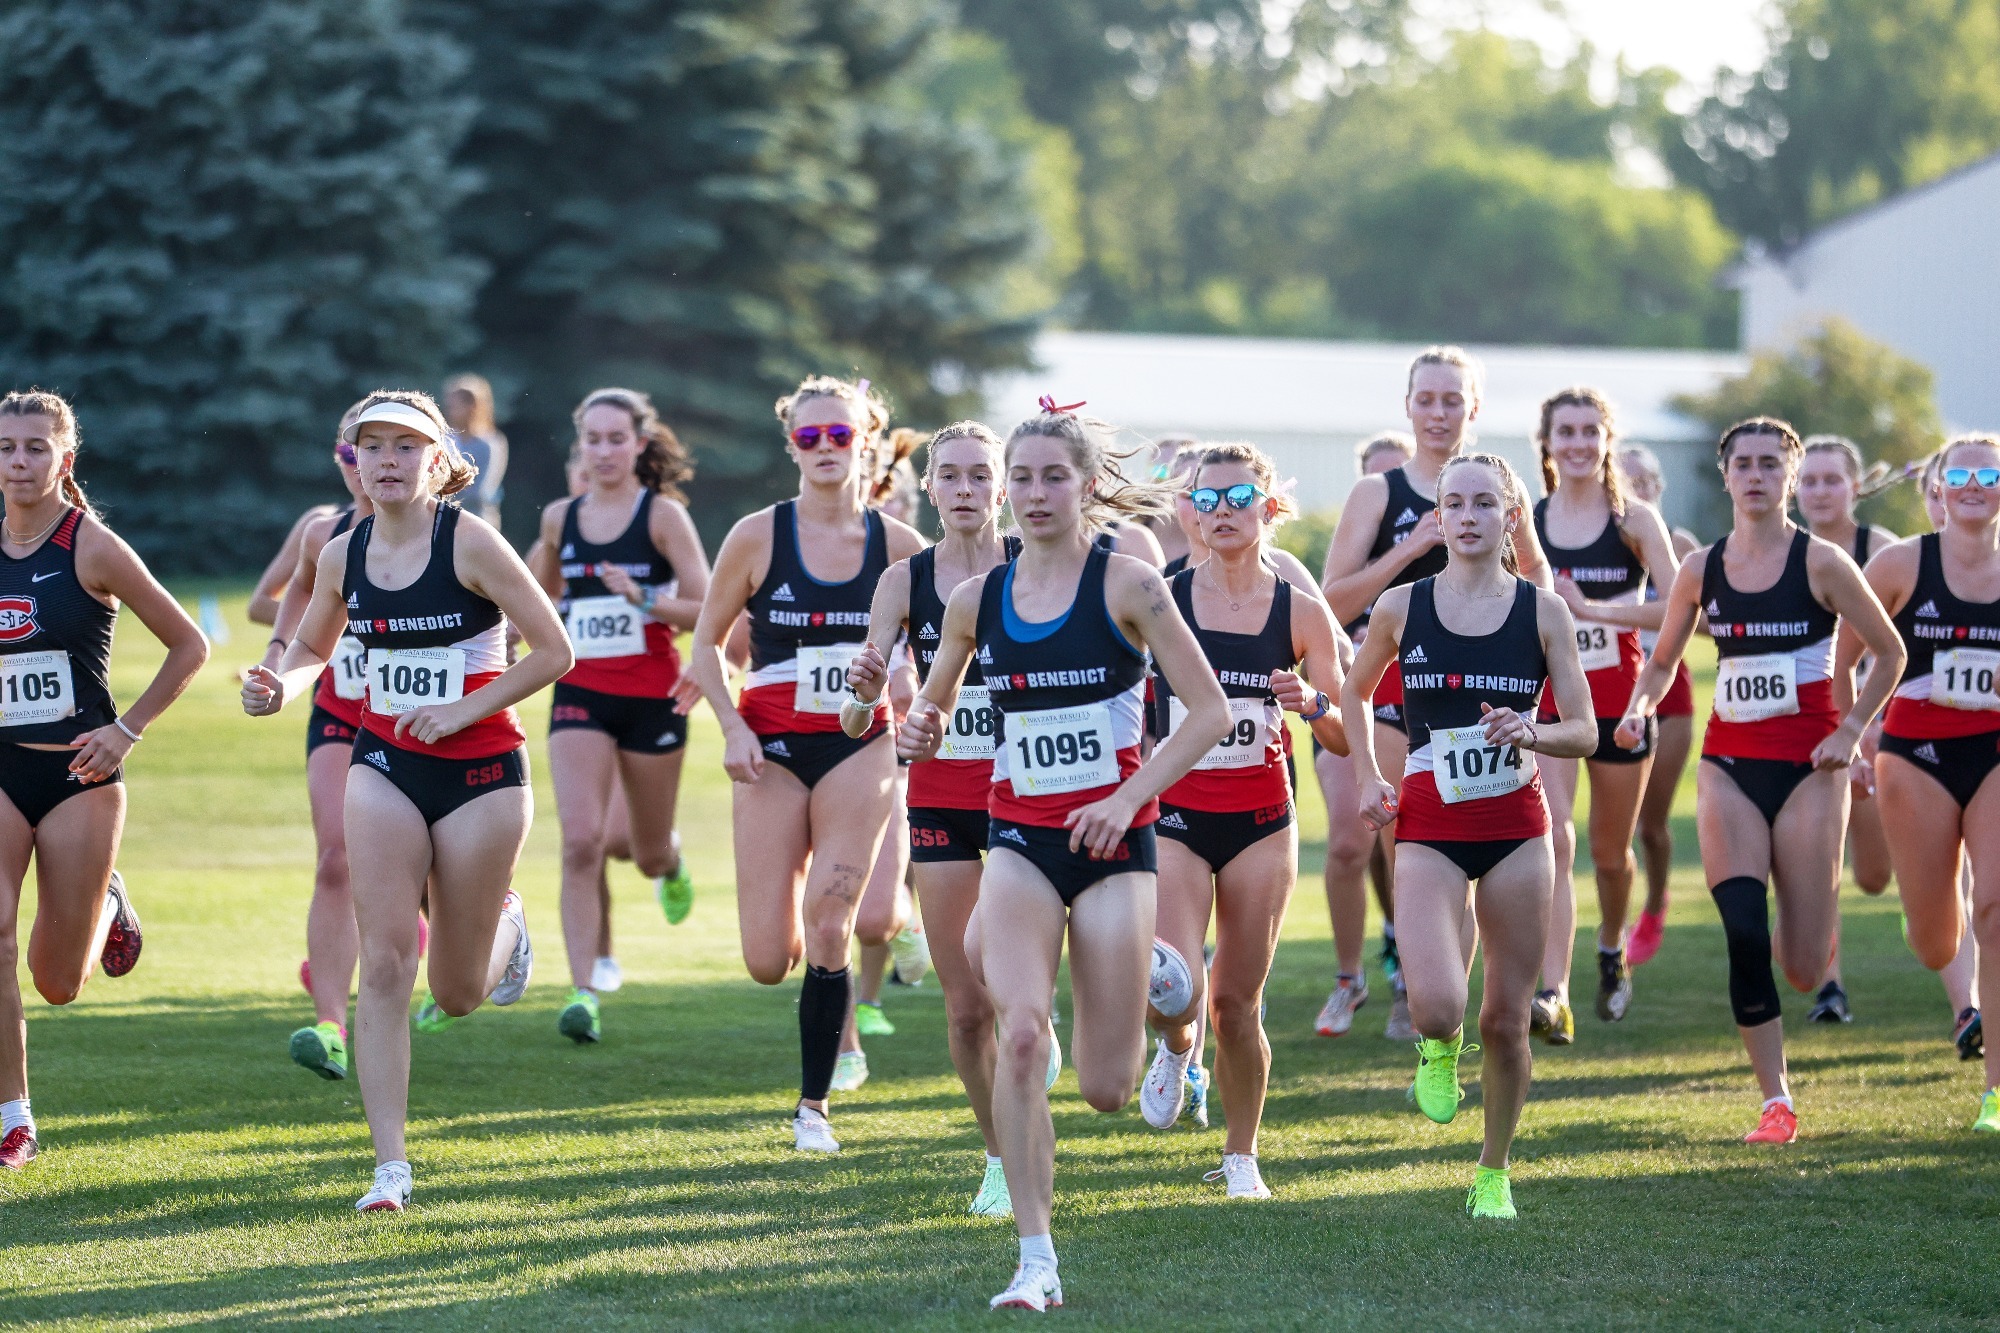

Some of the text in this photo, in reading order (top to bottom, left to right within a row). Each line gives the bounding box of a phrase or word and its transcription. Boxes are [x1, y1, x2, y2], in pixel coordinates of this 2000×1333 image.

[388, 613, 462, 632] BENEDICT
[577, 615, 632, 640] 1092
[769, 610, 810, 627] SAINT
[1746, 621, 1809, 637] BENEDICT
[1913, 623, 1954, 639] SAINT
[1404, 656, 1428, 664] adidas
[0, 671, 61, 704] 105
[378, 663, 448, 698] 1081
[1026, 667, 1106, 688] BENEDICT
[1404, 673, 1538, 694] SAINT BENEDICT
[1724, 674, 1787, 702] 1086
[1017, 729, 1101, 769] 1095
[364, 753, 391, 772] adidas
[1444, 745, 1523, 780] 1074
[465, 762, 505, 787] CSB
[1461, 784, 1492, 793] WAYZATA
[1159, 817, 1188, 831] adidas
[909, 827, 950, 847] CSB
